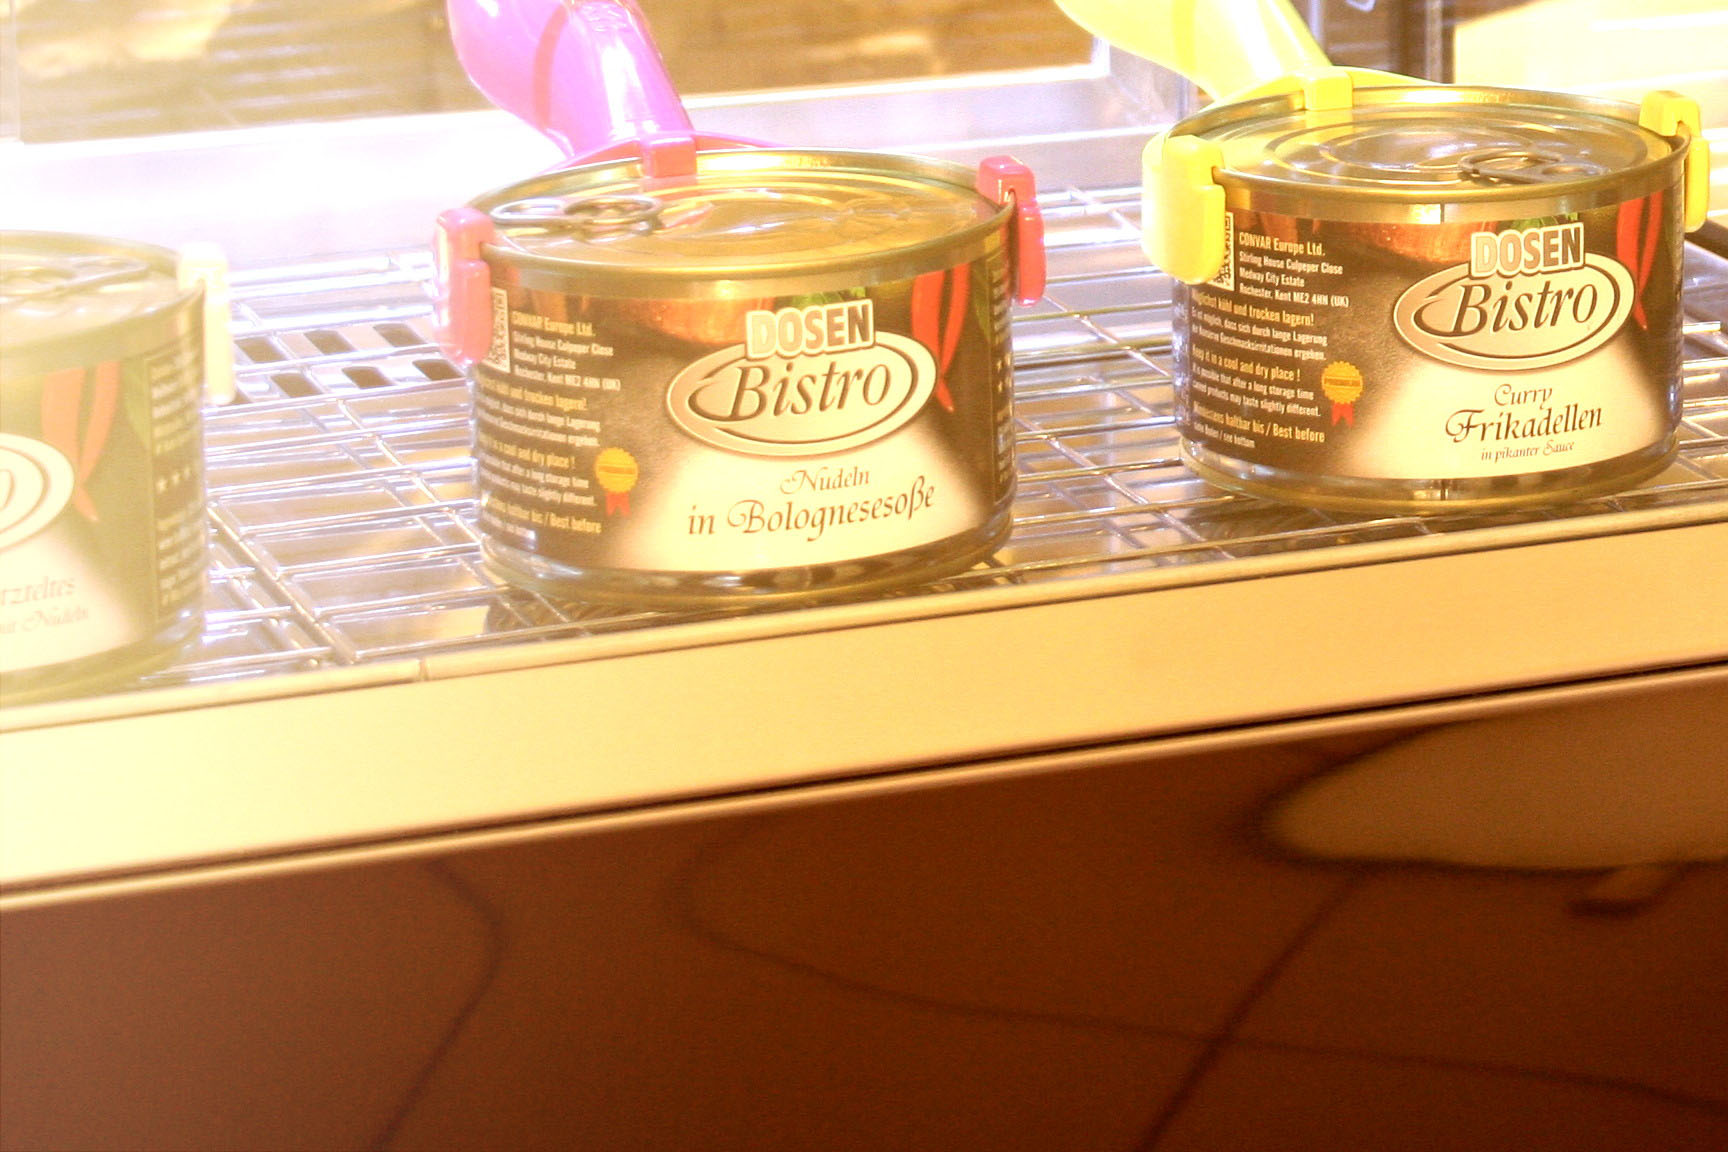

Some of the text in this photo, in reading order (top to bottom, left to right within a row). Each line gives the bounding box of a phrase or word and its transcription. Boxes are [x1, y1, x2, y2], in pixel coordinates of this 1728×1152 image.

[1240, 232, 1326, 257] CONVAR Europe Ltd.
[1473, 225, 1582, 275] DOSEN
[1265, 272, 1280, 287] City
[1281, 274, 1305, 288] Estate
[1321, 262, 1343, 275] Close
[1293, 292, 1310, 304] ME2
[1330, 294, 1349, 308] (UK)
[1414, 280, 1598, 338] Bistro
[1249, 304, 1280, 322] trocken
[1282, 310, 1314, 327] lagern!
[747, 301, 874, 358] DOSEN
[1240, 361, 1254, 374] and
[1255, 362, 1269, 379] dry
[1270, 366, 1294, 380] place
[688, 361, 891, 422] Bistro
[1253, 381, 1268, 395] long
[1495, 384, 1552, 410] Curry
[1252, 419, 1265, 433] bis
[1273, 423, 1293, 439] Best
[1295, 426, 1325, 443] before
[1445, 404, 1602, 443] Frikadellen
[1481, 439, 1575, 464] in pikanter Sauce
[780, 465, 870, 494] Nudeln
[688, 475, 935, 541] in Bolognesesoße
